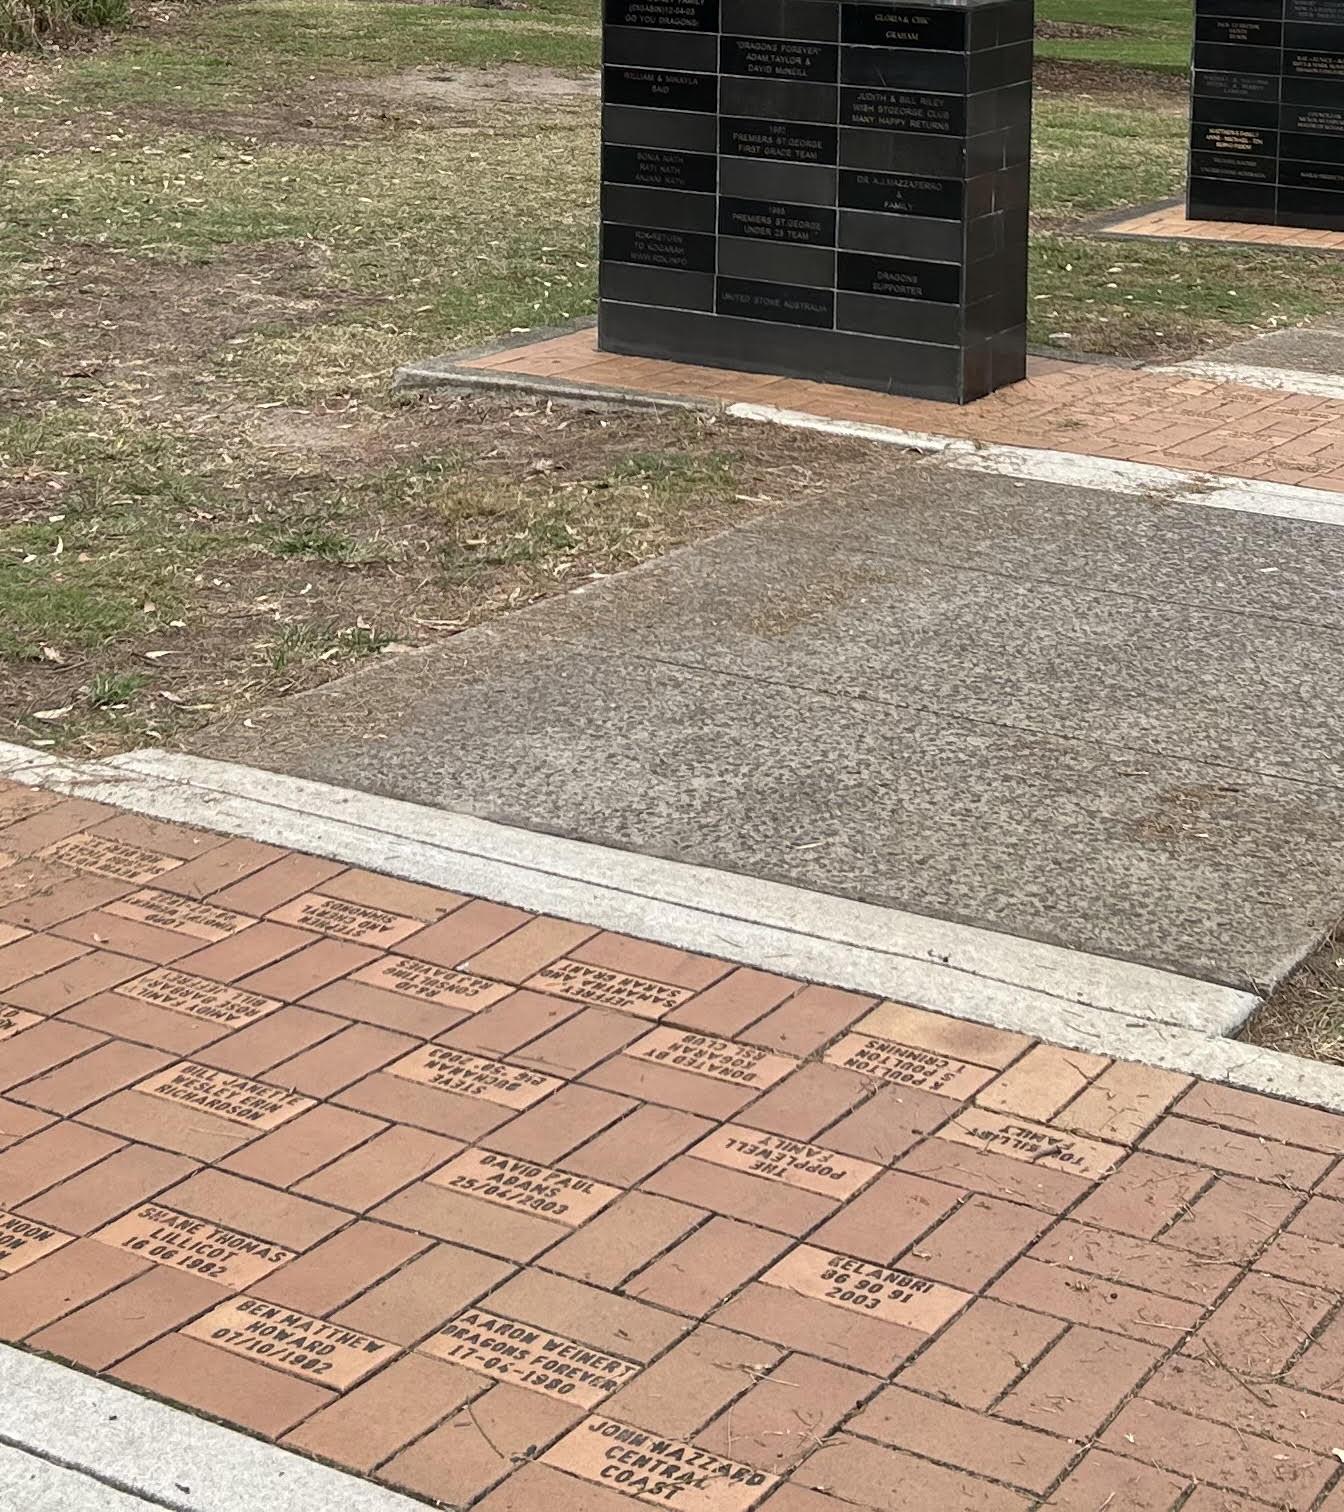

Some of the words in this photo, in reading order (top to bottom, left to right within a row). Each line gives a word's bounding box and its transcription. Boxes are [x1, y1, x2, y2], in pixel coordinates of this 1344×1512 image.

[643, 1048, 670, 1060] BY
[667, 1042, 756, 1069] KOGARAH
[681, 1034, 728, 1051] CLUB
[735, 1046, 767, 1061] RSL
[865, 1040, 949, 1068] CRIMMINS
[672, 1055, 757, 1082] DONATED
[843, 1057, 927, 1086] POULTON
[854, 1049, 938, 1077] POULTON
[939, 1072, 956, 1082] S
[171, 1074, 241, 1099] WESLEY
[239, 1095, 283, 1113] ERIN
[180, 1062, 227, 1082] BILL
[222, 1075, 304, 1106] JANETTE
[154, 1084, 264, 1121] RICHARDSON
[725, 1138, 846, 1180] POPPLEWELL
[757, 1136, 837, 1163] FAMILY
[479, 1154, 542, 1178] DAVID
[542, 1172, 594, 1194] PAUL
[486, 1172, 561, 1198] ADAMS
[748, 1161, 788, 1178] THE
[0, 1218, 55, 1242] NOON
[137, 1207, 205, 1235] SHANE
[206, 1228, 286, 1263] THOMAS
[149, 1227, 238, 1262] LILLICOT
[121, 1236, 150, 1250] 16
[148, 1245, 179, 1260] 06
[176, 1255, 227, 1278] 1982
[825, 1286, 881, 1309] 2003
[887, 1289, 914, 1303] 91
[236, 1300, 281, 1319] BEN
[278, 1314, 384, 1353] MATTHEW
[245, 1320, 336, 1356] HOWARD
[211, 1328, 332, 1374] 07/10/1982
[440, 1324, 530, 1360] DRAGONS
[529, 1355, 625, 1392] FOREVER
[460, 1313, 540, 1344] AARON
[542, 1338, 642, 1379] WEINERT
[588, 1421, 650, 1447] JOHN
[650, 1441, 766, 1486] HAZZARD
[605, 1445, 717, 1490] CENTRAL
[600, 1464, 684, 1500] COAST
